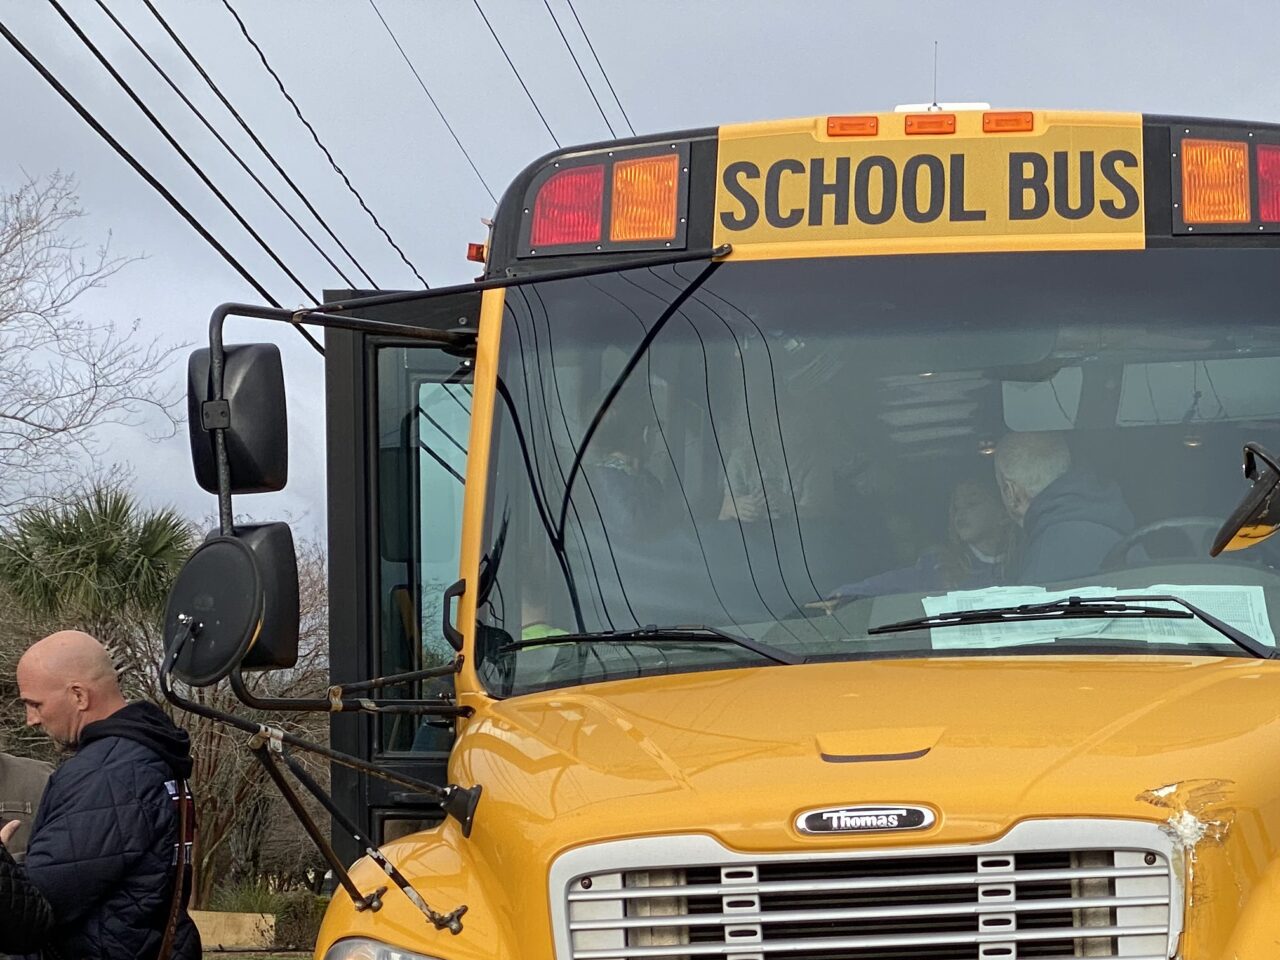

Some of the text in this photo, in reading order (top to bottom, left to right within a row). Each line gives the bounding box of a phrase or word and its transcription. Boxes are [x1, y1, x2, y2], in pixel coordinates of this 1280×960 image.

[719, 149, 1140, 232] SCHOOL BUS
[822, 809, 907, 831] Thomas
